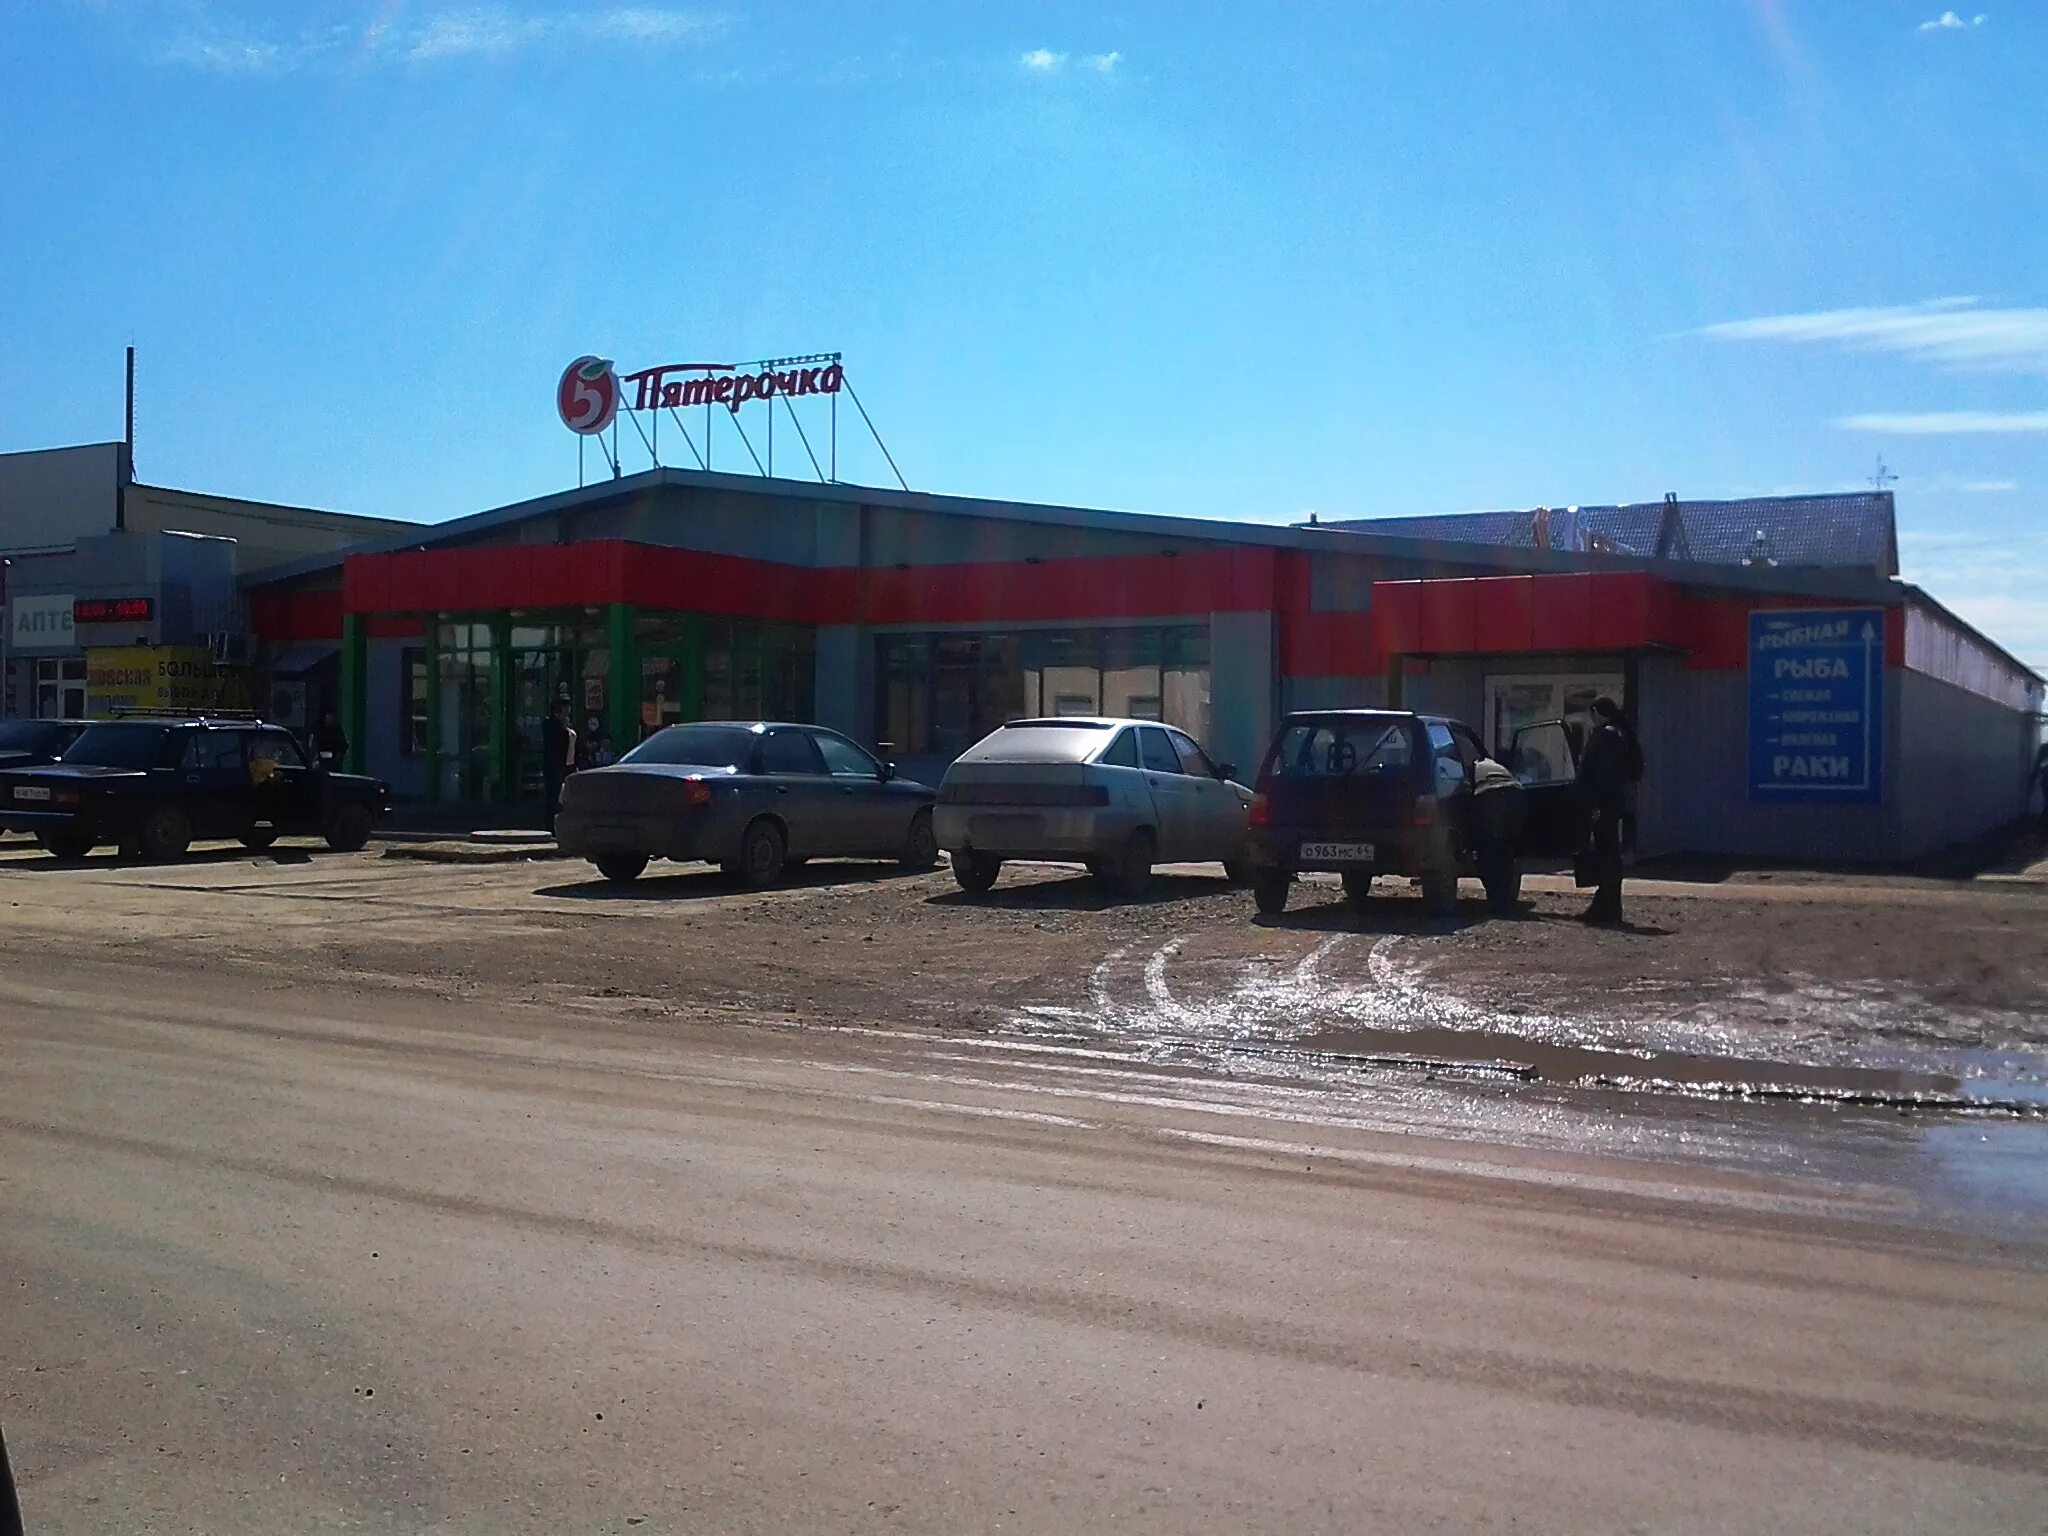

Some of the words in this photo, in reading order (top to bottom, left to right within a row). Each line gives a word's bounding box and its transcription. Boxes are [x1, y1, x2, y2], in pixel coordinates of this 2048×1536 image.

[624, 362, 844, 413] Пятерочка
[1759, 619, 1849, 650] РЫБНАЯ
[1774, 657, 1849, 679] РЫБА
[1774, 755, 1849, 778] РАКИ
